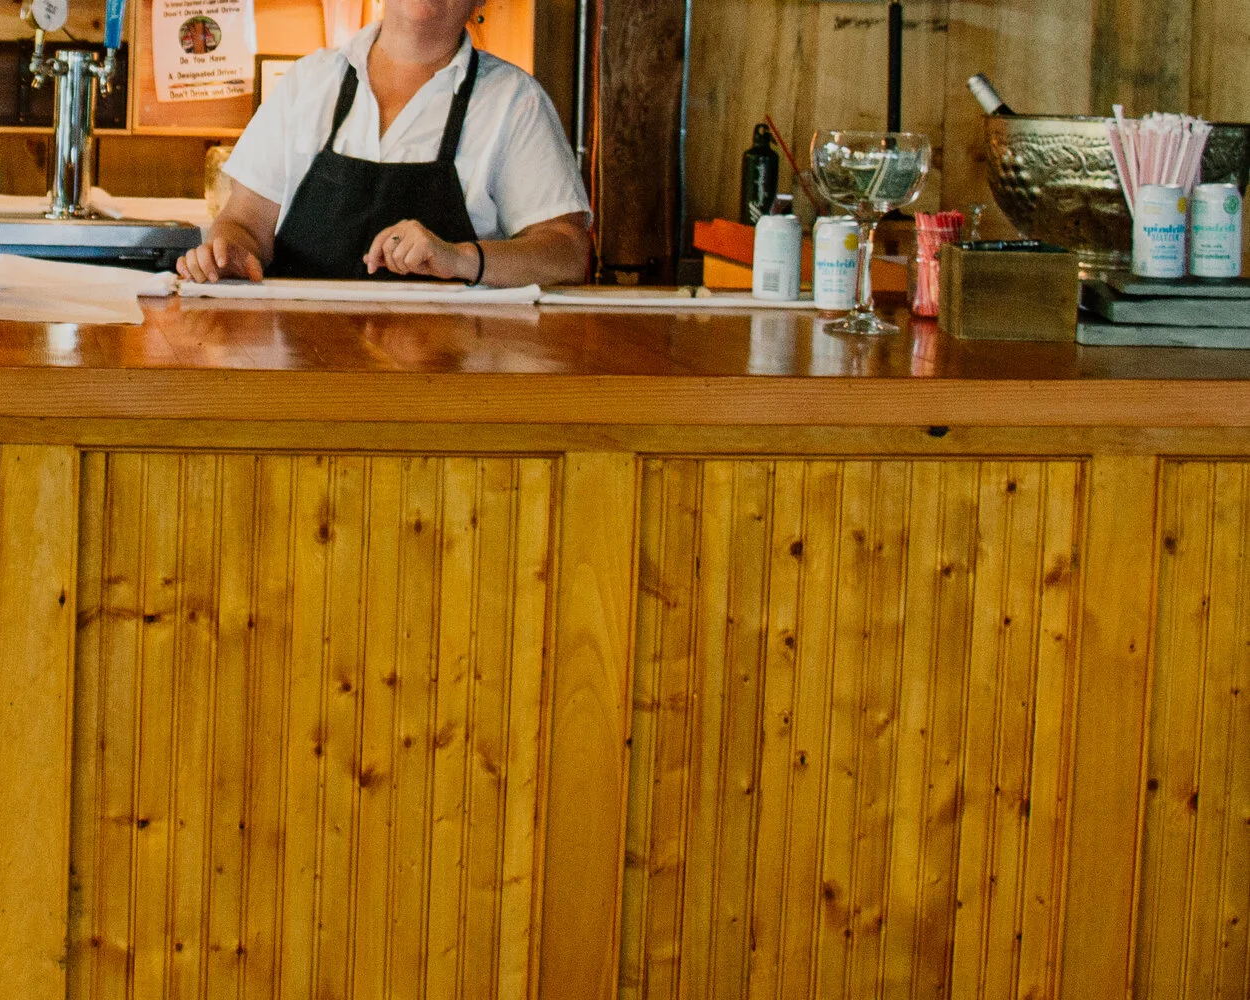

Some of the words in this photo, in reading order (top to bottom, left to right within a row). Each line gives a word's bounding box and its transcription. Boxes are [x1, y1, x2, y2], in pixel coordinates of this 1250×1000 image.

[179, 57, 189, 65] Do
[193, 55, 205, 64] You
[209, 55, 227, 63] Have
[176, 70, 215, 80] Designated
